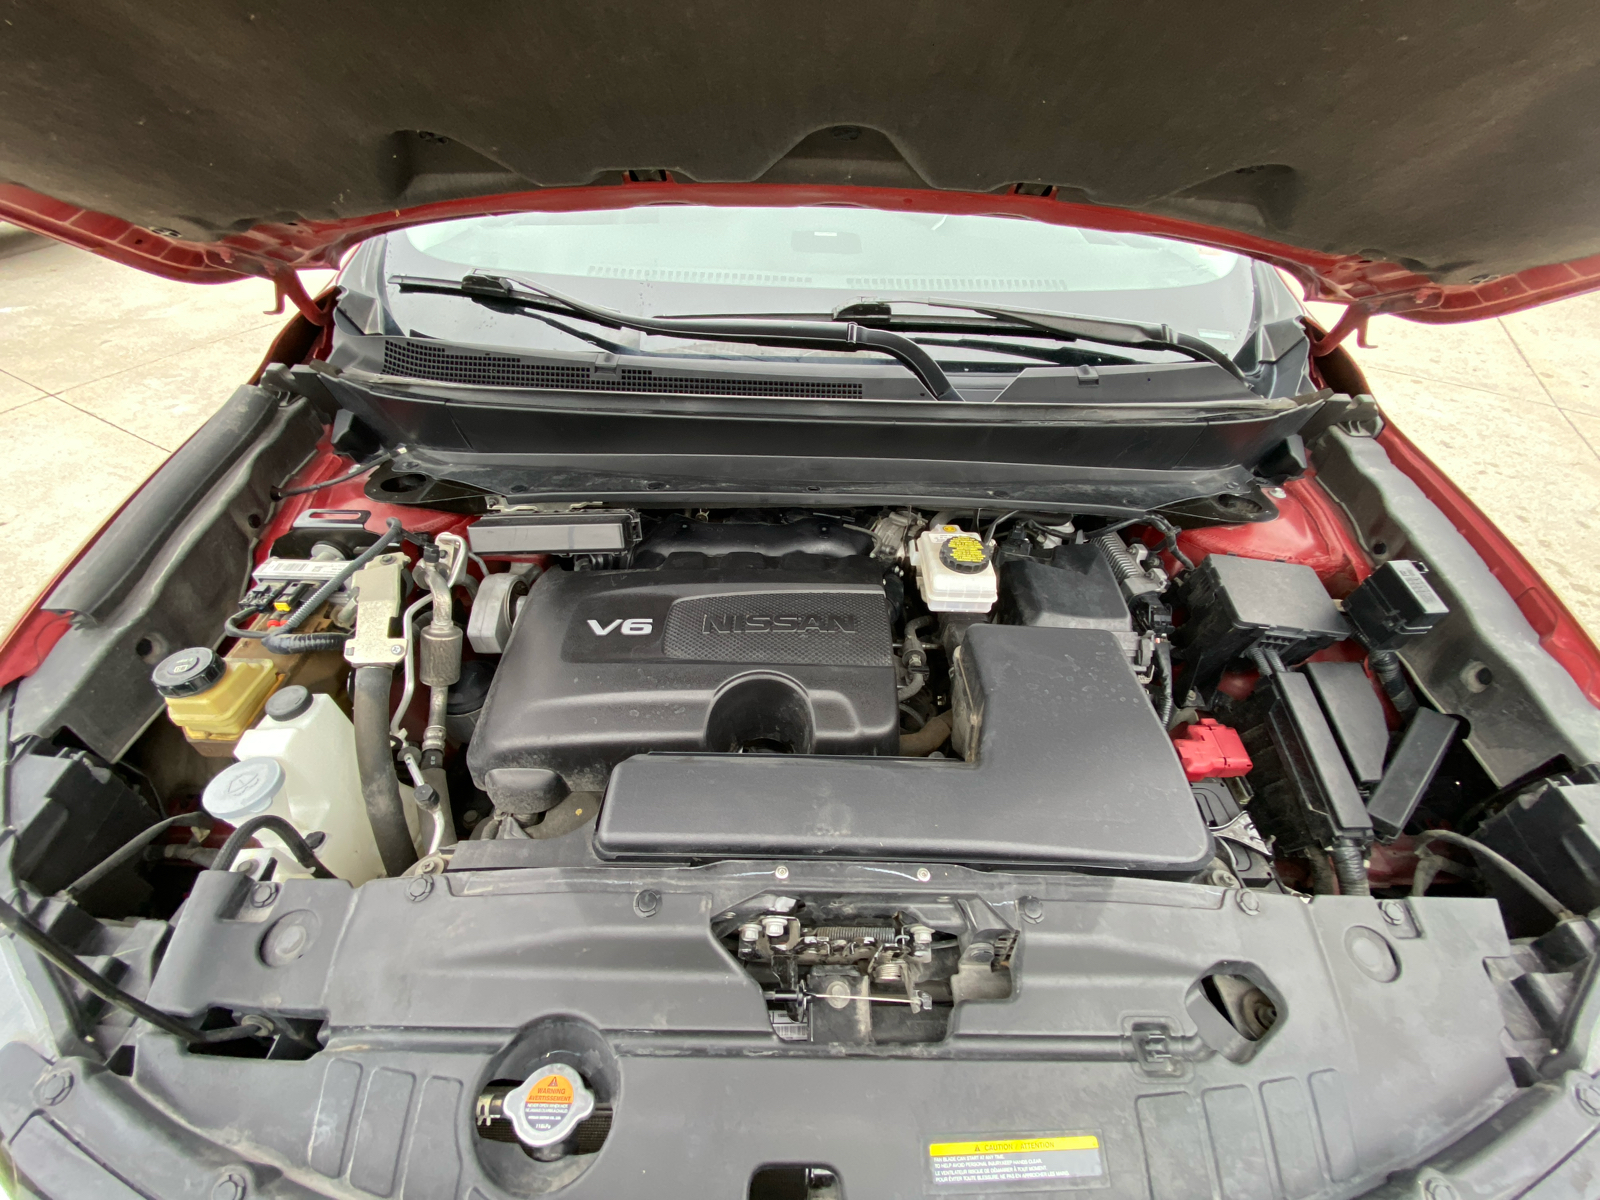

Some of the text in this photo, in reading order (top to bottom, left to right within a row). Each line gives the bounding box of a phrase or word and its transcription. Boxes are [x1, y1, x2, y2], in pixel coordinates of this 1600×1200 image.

[587, 618, 653, 636] V6
[702, 613, 856, 634] NISSAN
[984, 1143, 1013, 1151] CAUTION
[1020, 1141, 1055, 1150] ATTENTION
